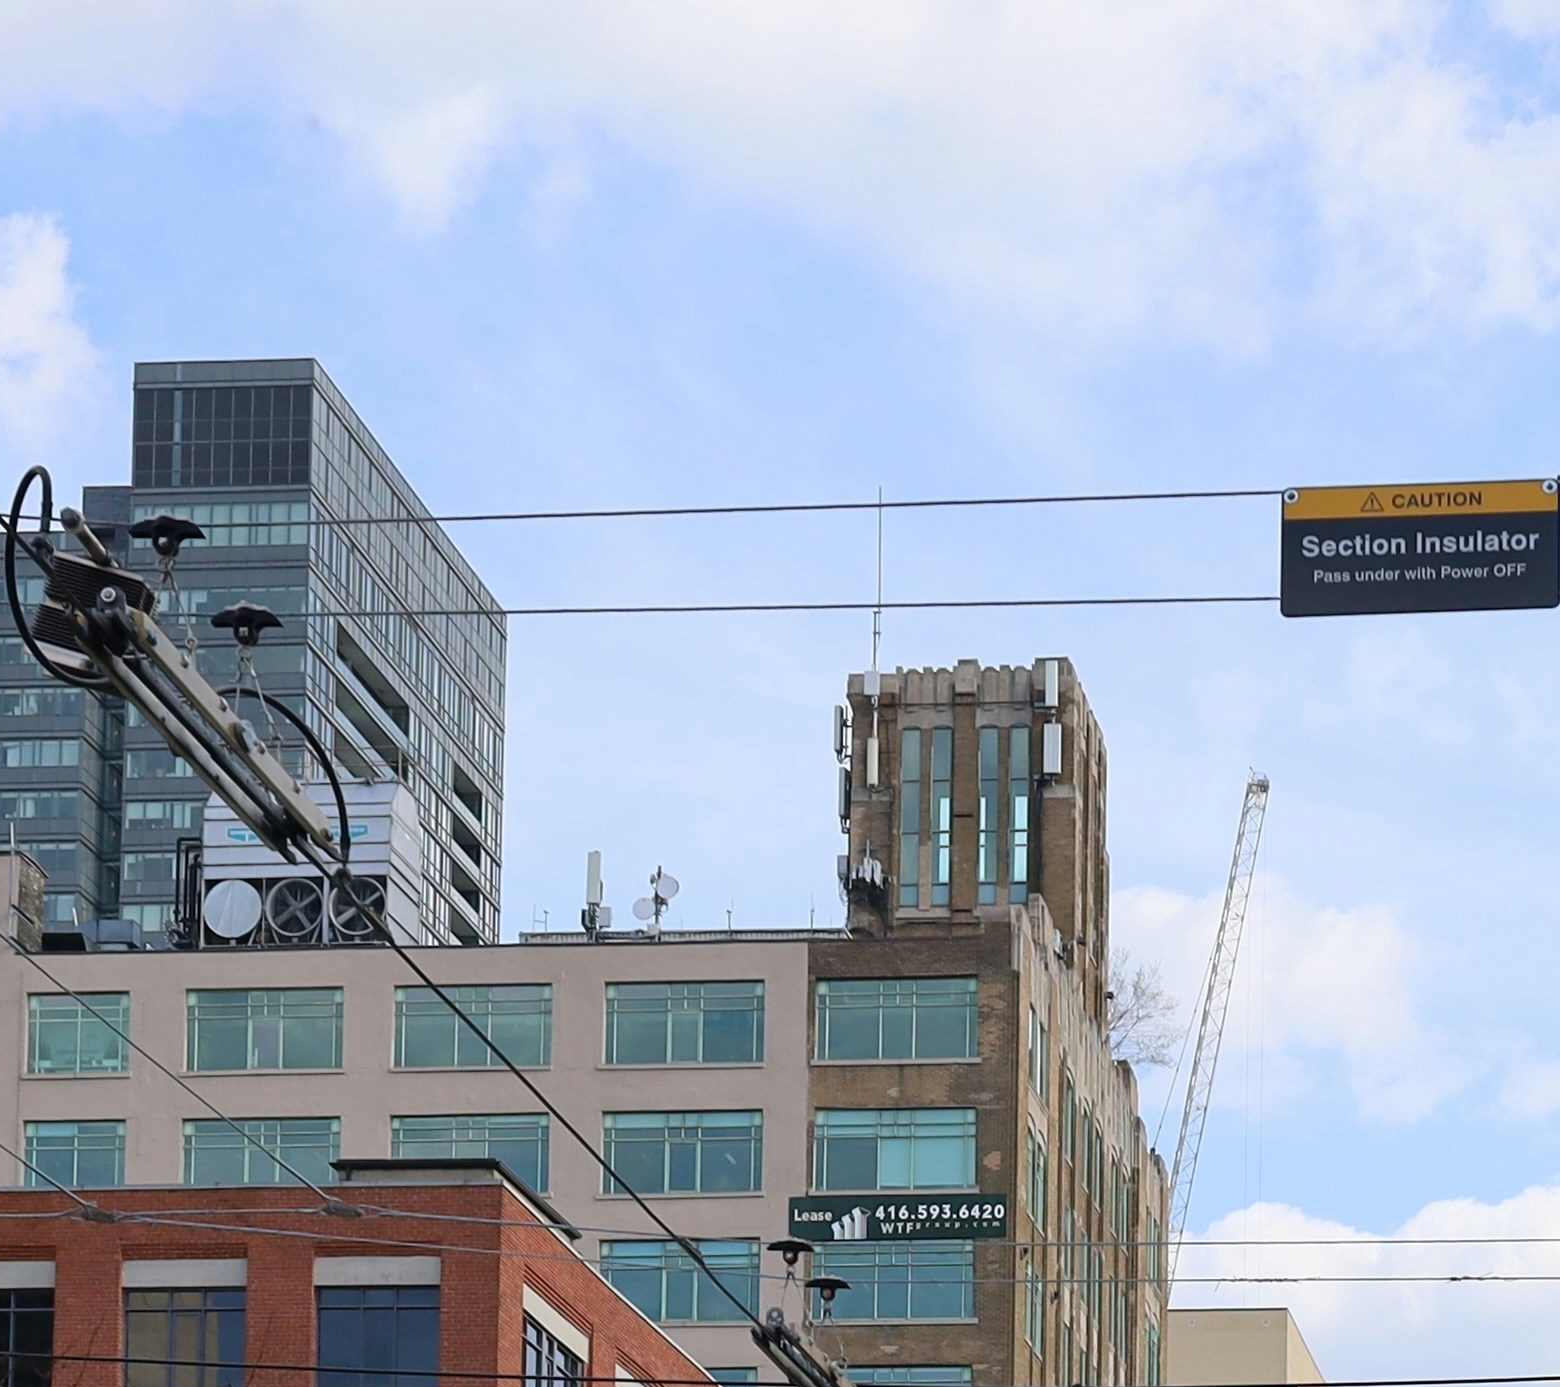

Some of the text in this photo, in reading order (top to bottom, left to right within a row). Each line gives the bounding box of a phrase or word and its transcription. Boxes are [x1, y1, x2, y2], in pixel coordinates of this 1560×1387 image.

[1391, 491, 1483, 509] CAUTION
[1301, 530, 1540, 558] Section Insulator
[1313, 562, 1527, 584] Pass under with Power OFF
[794, 1203, 1005, 1223] Lease 416.593.6420
